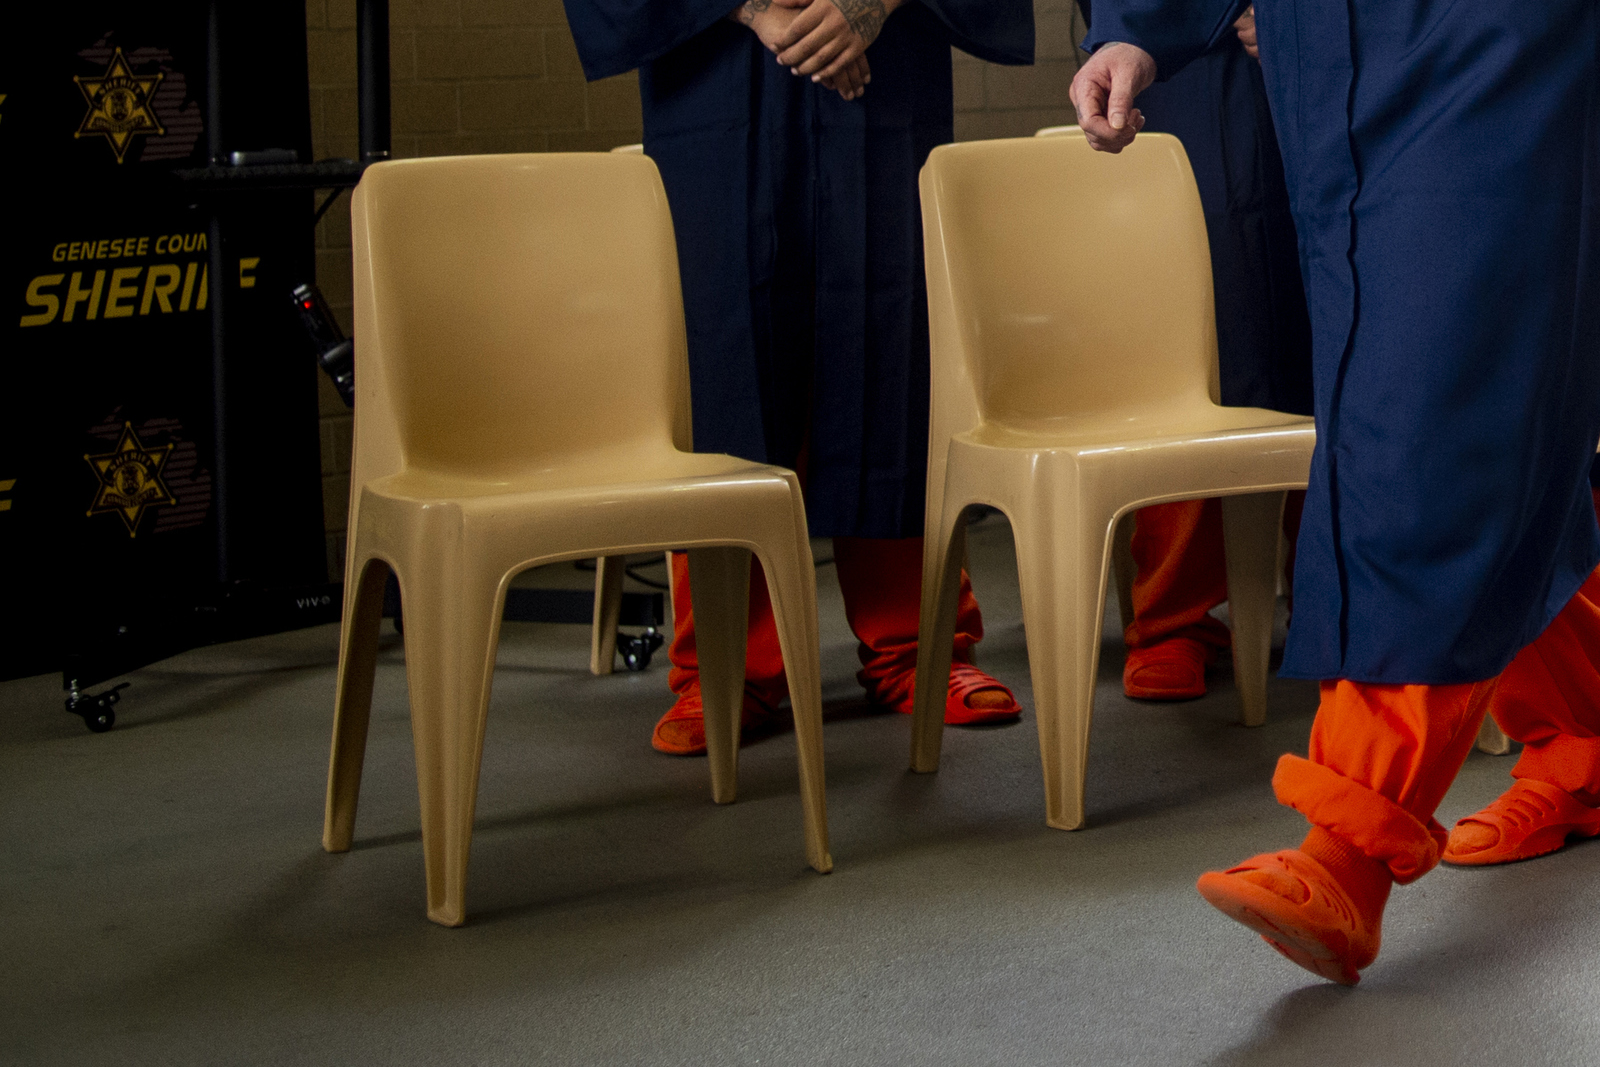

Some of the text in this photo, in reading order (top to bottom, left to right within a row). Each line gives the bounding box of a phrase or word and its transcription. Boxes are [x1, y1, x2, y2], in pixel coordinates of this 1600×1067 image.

[52, 232, 208, 263] GENESEE COUN
[19, 255, 261, 328] SHERIF
